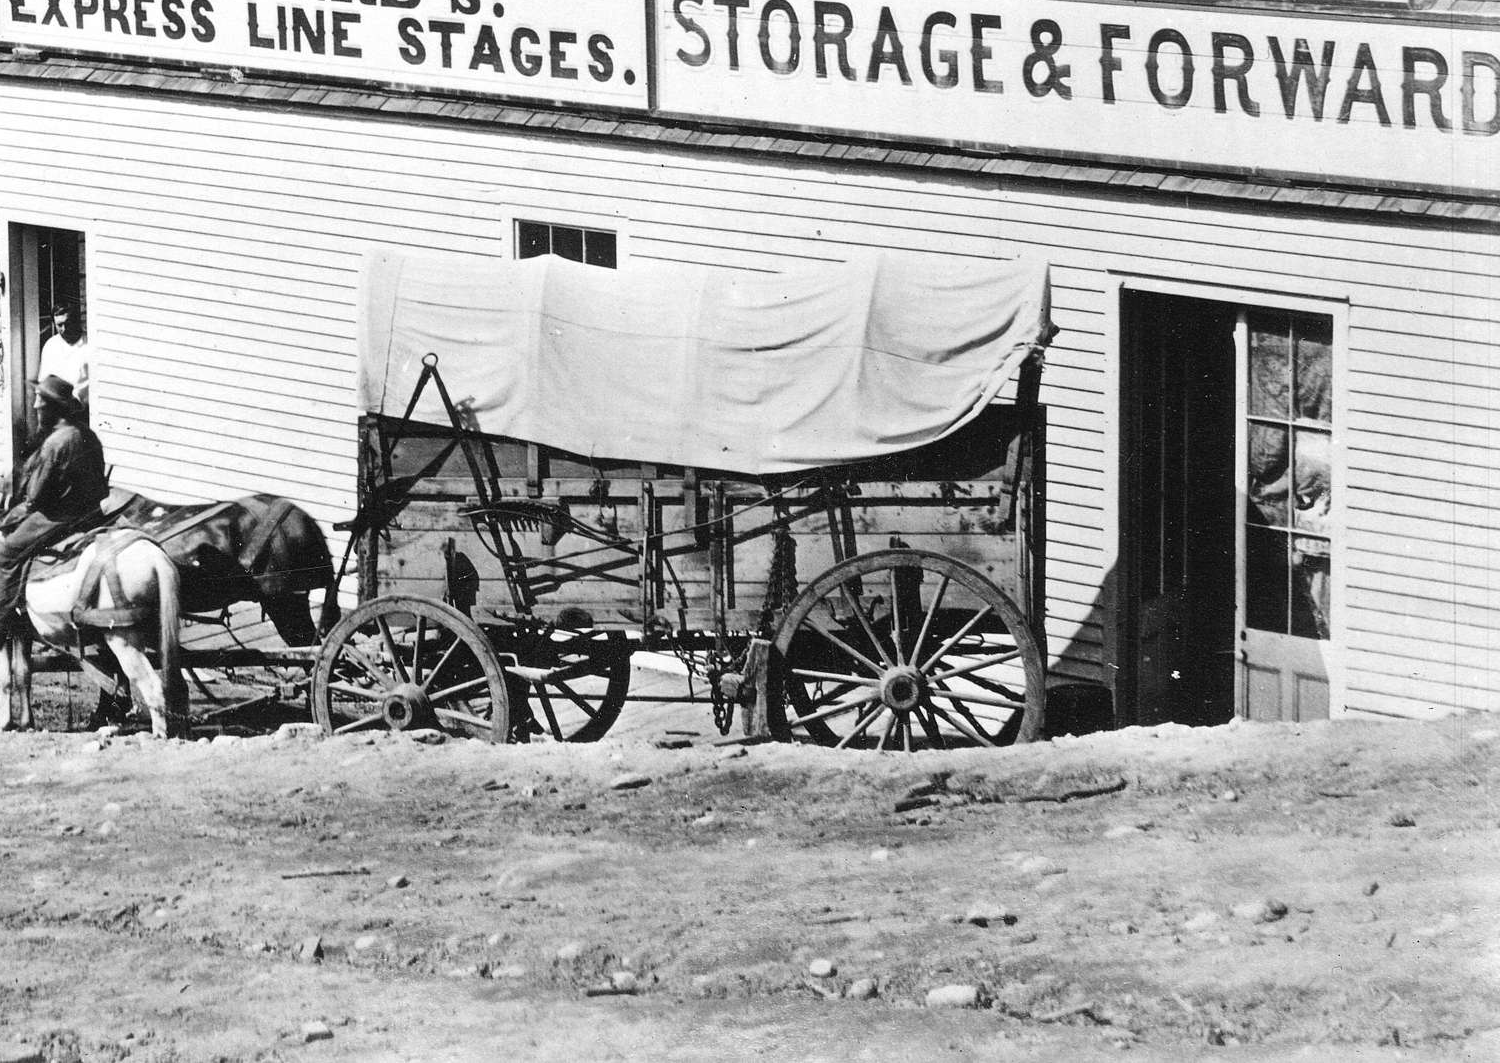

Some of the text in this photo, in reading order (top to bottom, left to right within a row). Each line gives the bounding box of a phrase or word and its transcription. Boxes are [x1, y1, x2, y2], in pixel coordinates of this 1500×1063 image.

[247, 2, 363, 59] LINE
[397, 17, 636, 86] STAGES.
[1022, 18, 1073, 101] &
[1098, 22, 1500, 137] FORWARD
